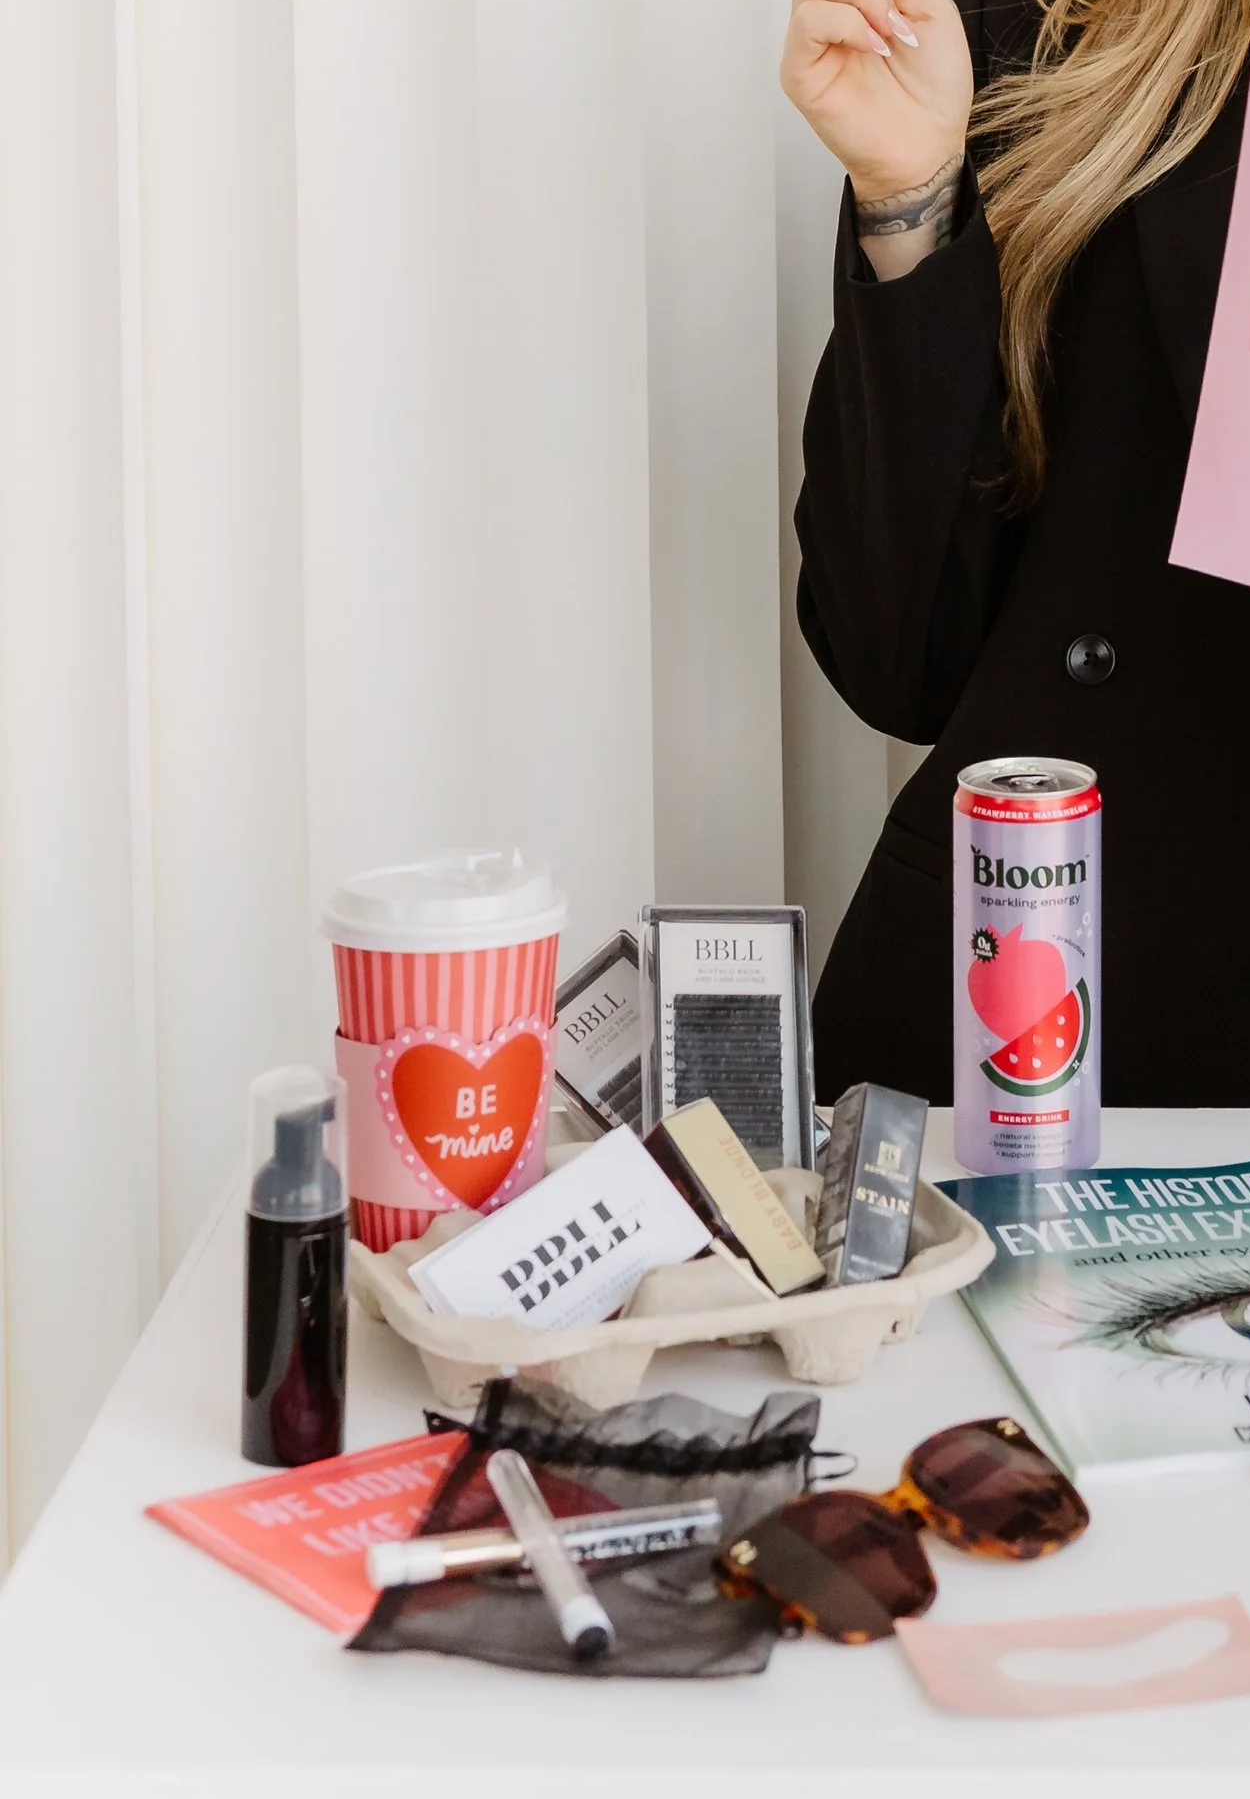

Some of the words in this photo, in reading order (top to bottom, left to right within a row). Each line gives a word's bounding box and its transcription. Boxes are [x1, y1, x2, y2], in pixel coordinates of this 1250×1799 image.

[972, 805, 1030, 820] STRAWBERRY
[1032, 803, 1089, 820] WATERMELON
[972, 851, 1088, 890] Bloom
[980, 894, 1038, 911] sparkling
[1040, 894, 1081, 908] energy
[695, 938, 763, 962] BBLL
[563, 991, 627, 1045] BBLL
[455, 1084, 497, 1119] BE
[997, 1113, 1033, 1124] ENERGY
[1035, 1112, 1063, 1123] DRINK
[424, 1123, 514, 1160] mine
[854, 1185, 911, 1216] STAIN
[1035, 1178, 1130, 1214] THE
[995, 1212, 1197, 1258] EYELASH
[1074, 1250, 1126, 1269] and
[1130, 1244, 1212, 1263] other
[234, 1492, 325, 1528] WE
[301, 1509, 411, 1559] LIKE
